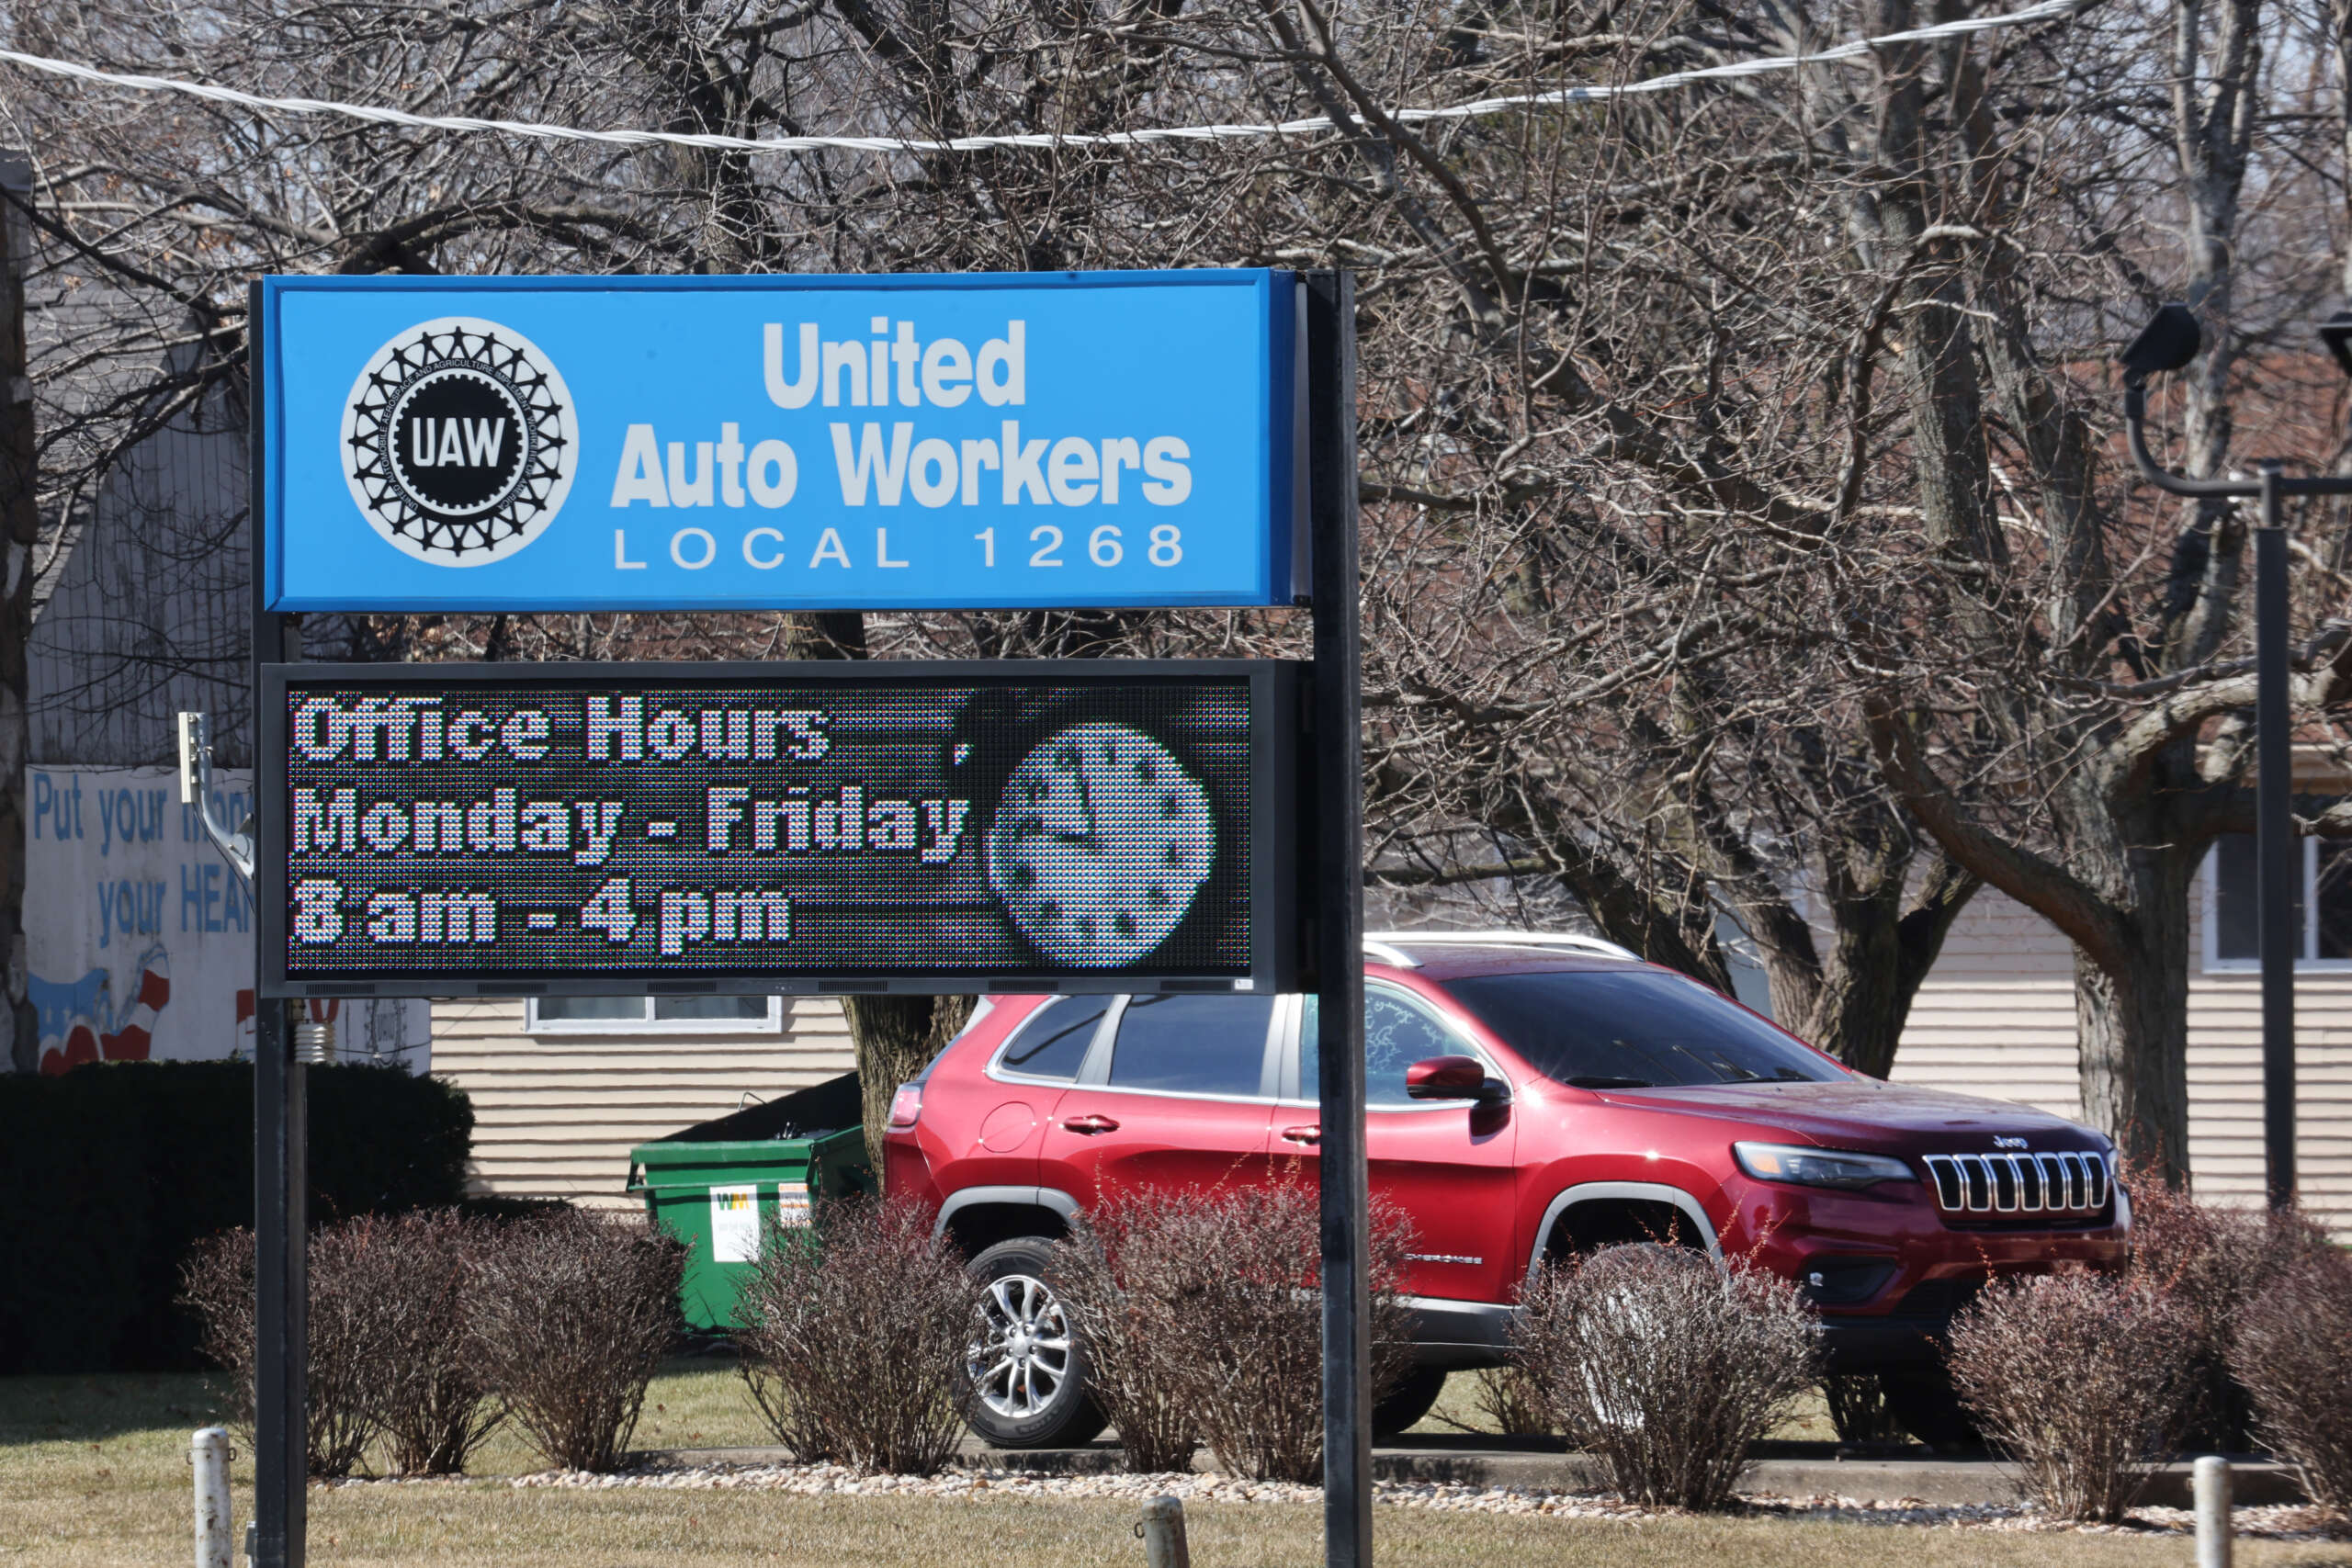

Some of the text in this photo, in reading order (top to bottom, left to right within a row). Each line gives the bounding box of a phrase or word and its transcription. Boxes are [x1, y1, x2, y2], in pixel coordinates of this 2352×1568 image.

[414, 365, 433, 380] AND
[434, 358, 494, 375] AGRICULTURE
[763, 316, 1026, 410] United
[382, 376, 416, 425] AEROSPACE
[494, 369, 532, 412] IMPLEMENT
[379, 425, 397, 483] AUTOMOBILE
[413, 416, 505, 468] UAW
[610, 420, 1193, 509] Auto Workers
[392, 484, 419, 511] UNITED
[615, 524, 1183, 570] LOCAL 1268
[293, 695, 831, 761] Office Hours
[33, 773, 84, 841] Put
[98, 787, 167, 857] your
[293, 785, 971, 865] Monday - Friday
[97, 879, 167, 949] your
[293, 877, 791, 955] 8 am - 4 pm
[1993, 1134, 2029, 1149] Jeep
[717, 1192, 750, 1211] WM
